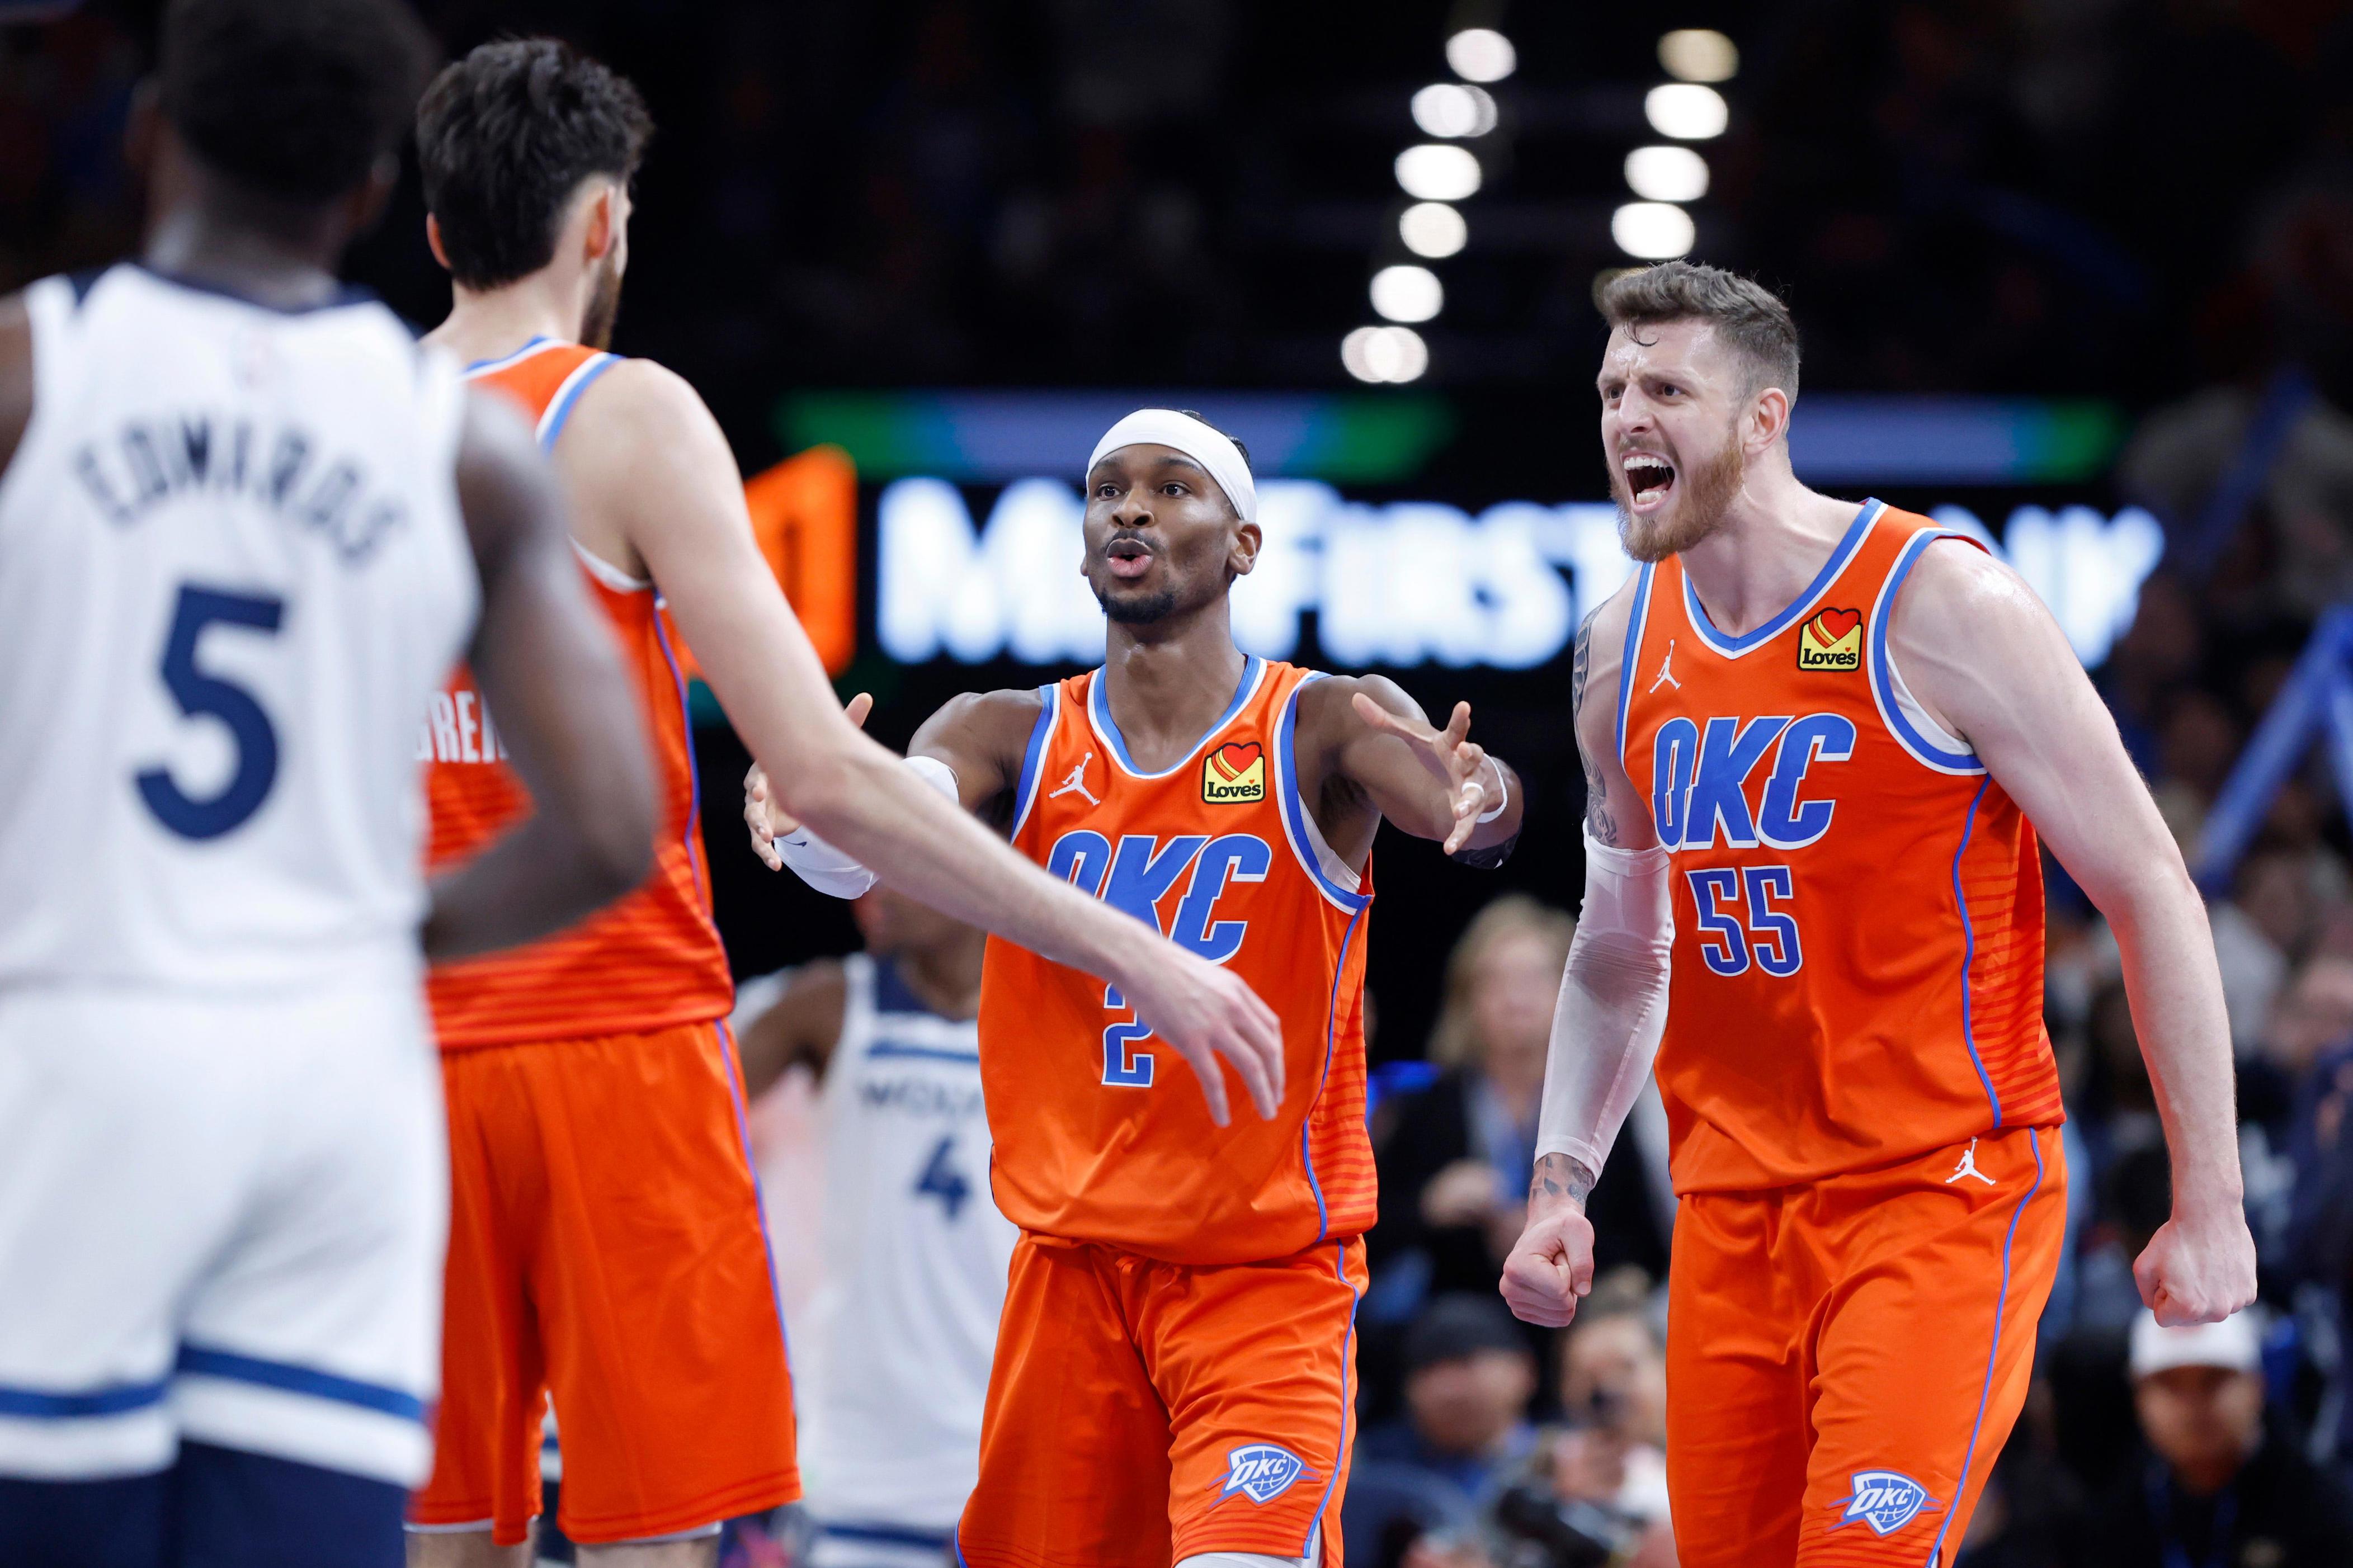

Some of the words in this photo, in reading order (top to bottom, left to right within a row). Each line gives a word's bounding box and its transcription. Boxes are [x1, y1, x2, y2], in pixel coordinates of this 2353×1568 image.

[134, 583, 283, 843] 5
[1651, 712, 1857, 854] OKC
[1684, 865, 1803, 978] 55
[1101, 981, 1154, 1088] 2
[913, 1132, 972, 1226] 4
[1224, 1458, 1287, 1491] OKC
[1846, 1487, 1912, 1516] OKC
